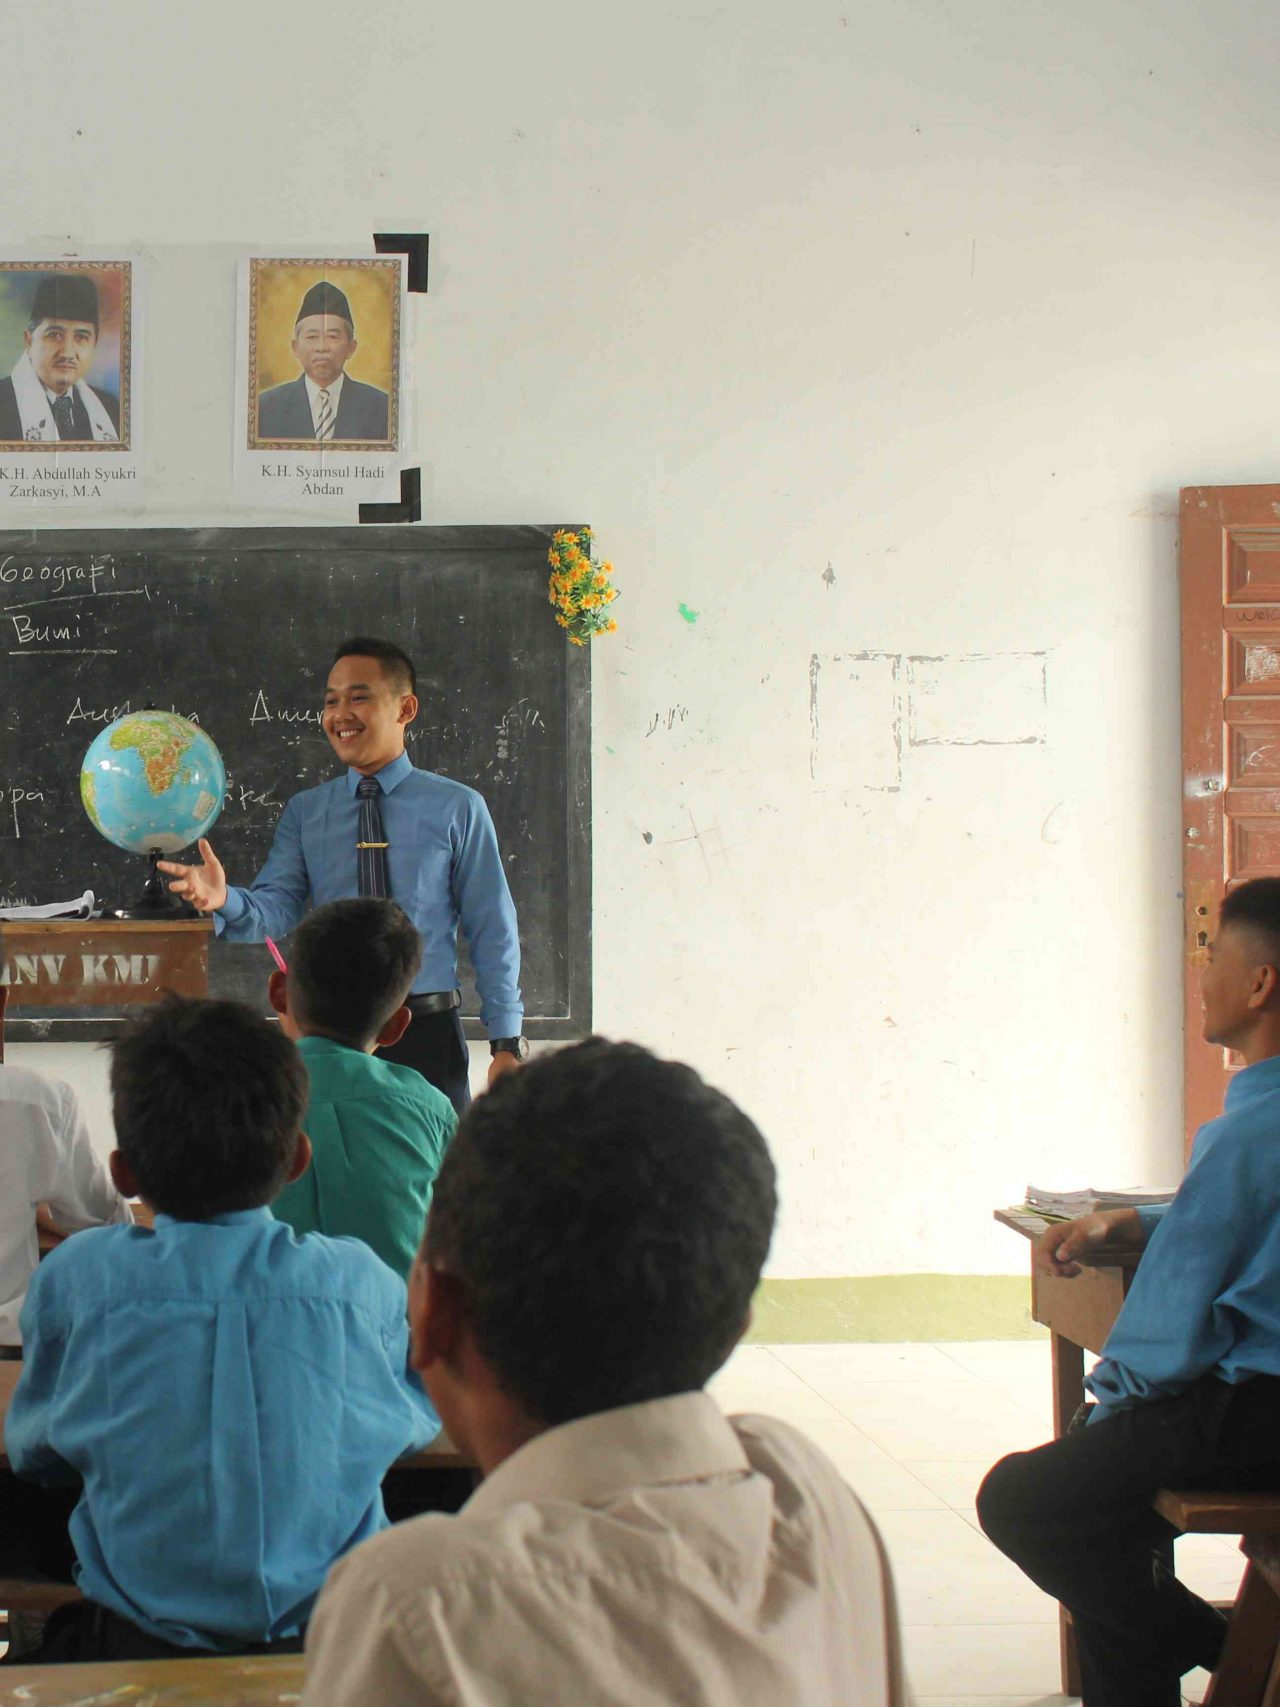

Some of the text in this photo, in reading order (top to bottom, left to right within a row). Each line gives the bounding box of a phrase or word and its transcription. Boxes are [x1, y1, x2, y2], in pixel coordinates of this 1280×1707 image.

[0, 467, 29, 480] K.H.
[32, 467, 91, 480] Abdullah
[94, 467, 136, 482] Syukri
[261, 465, 384, 480] K.H. Syamsul Hadi
[9, 485, 102, 500] Zarkasyi, M.A
[302, 483, 344, 495] Abdan
[0, 556, 116, 593] Geografi
[12, 613, 81, 643] Bumi
